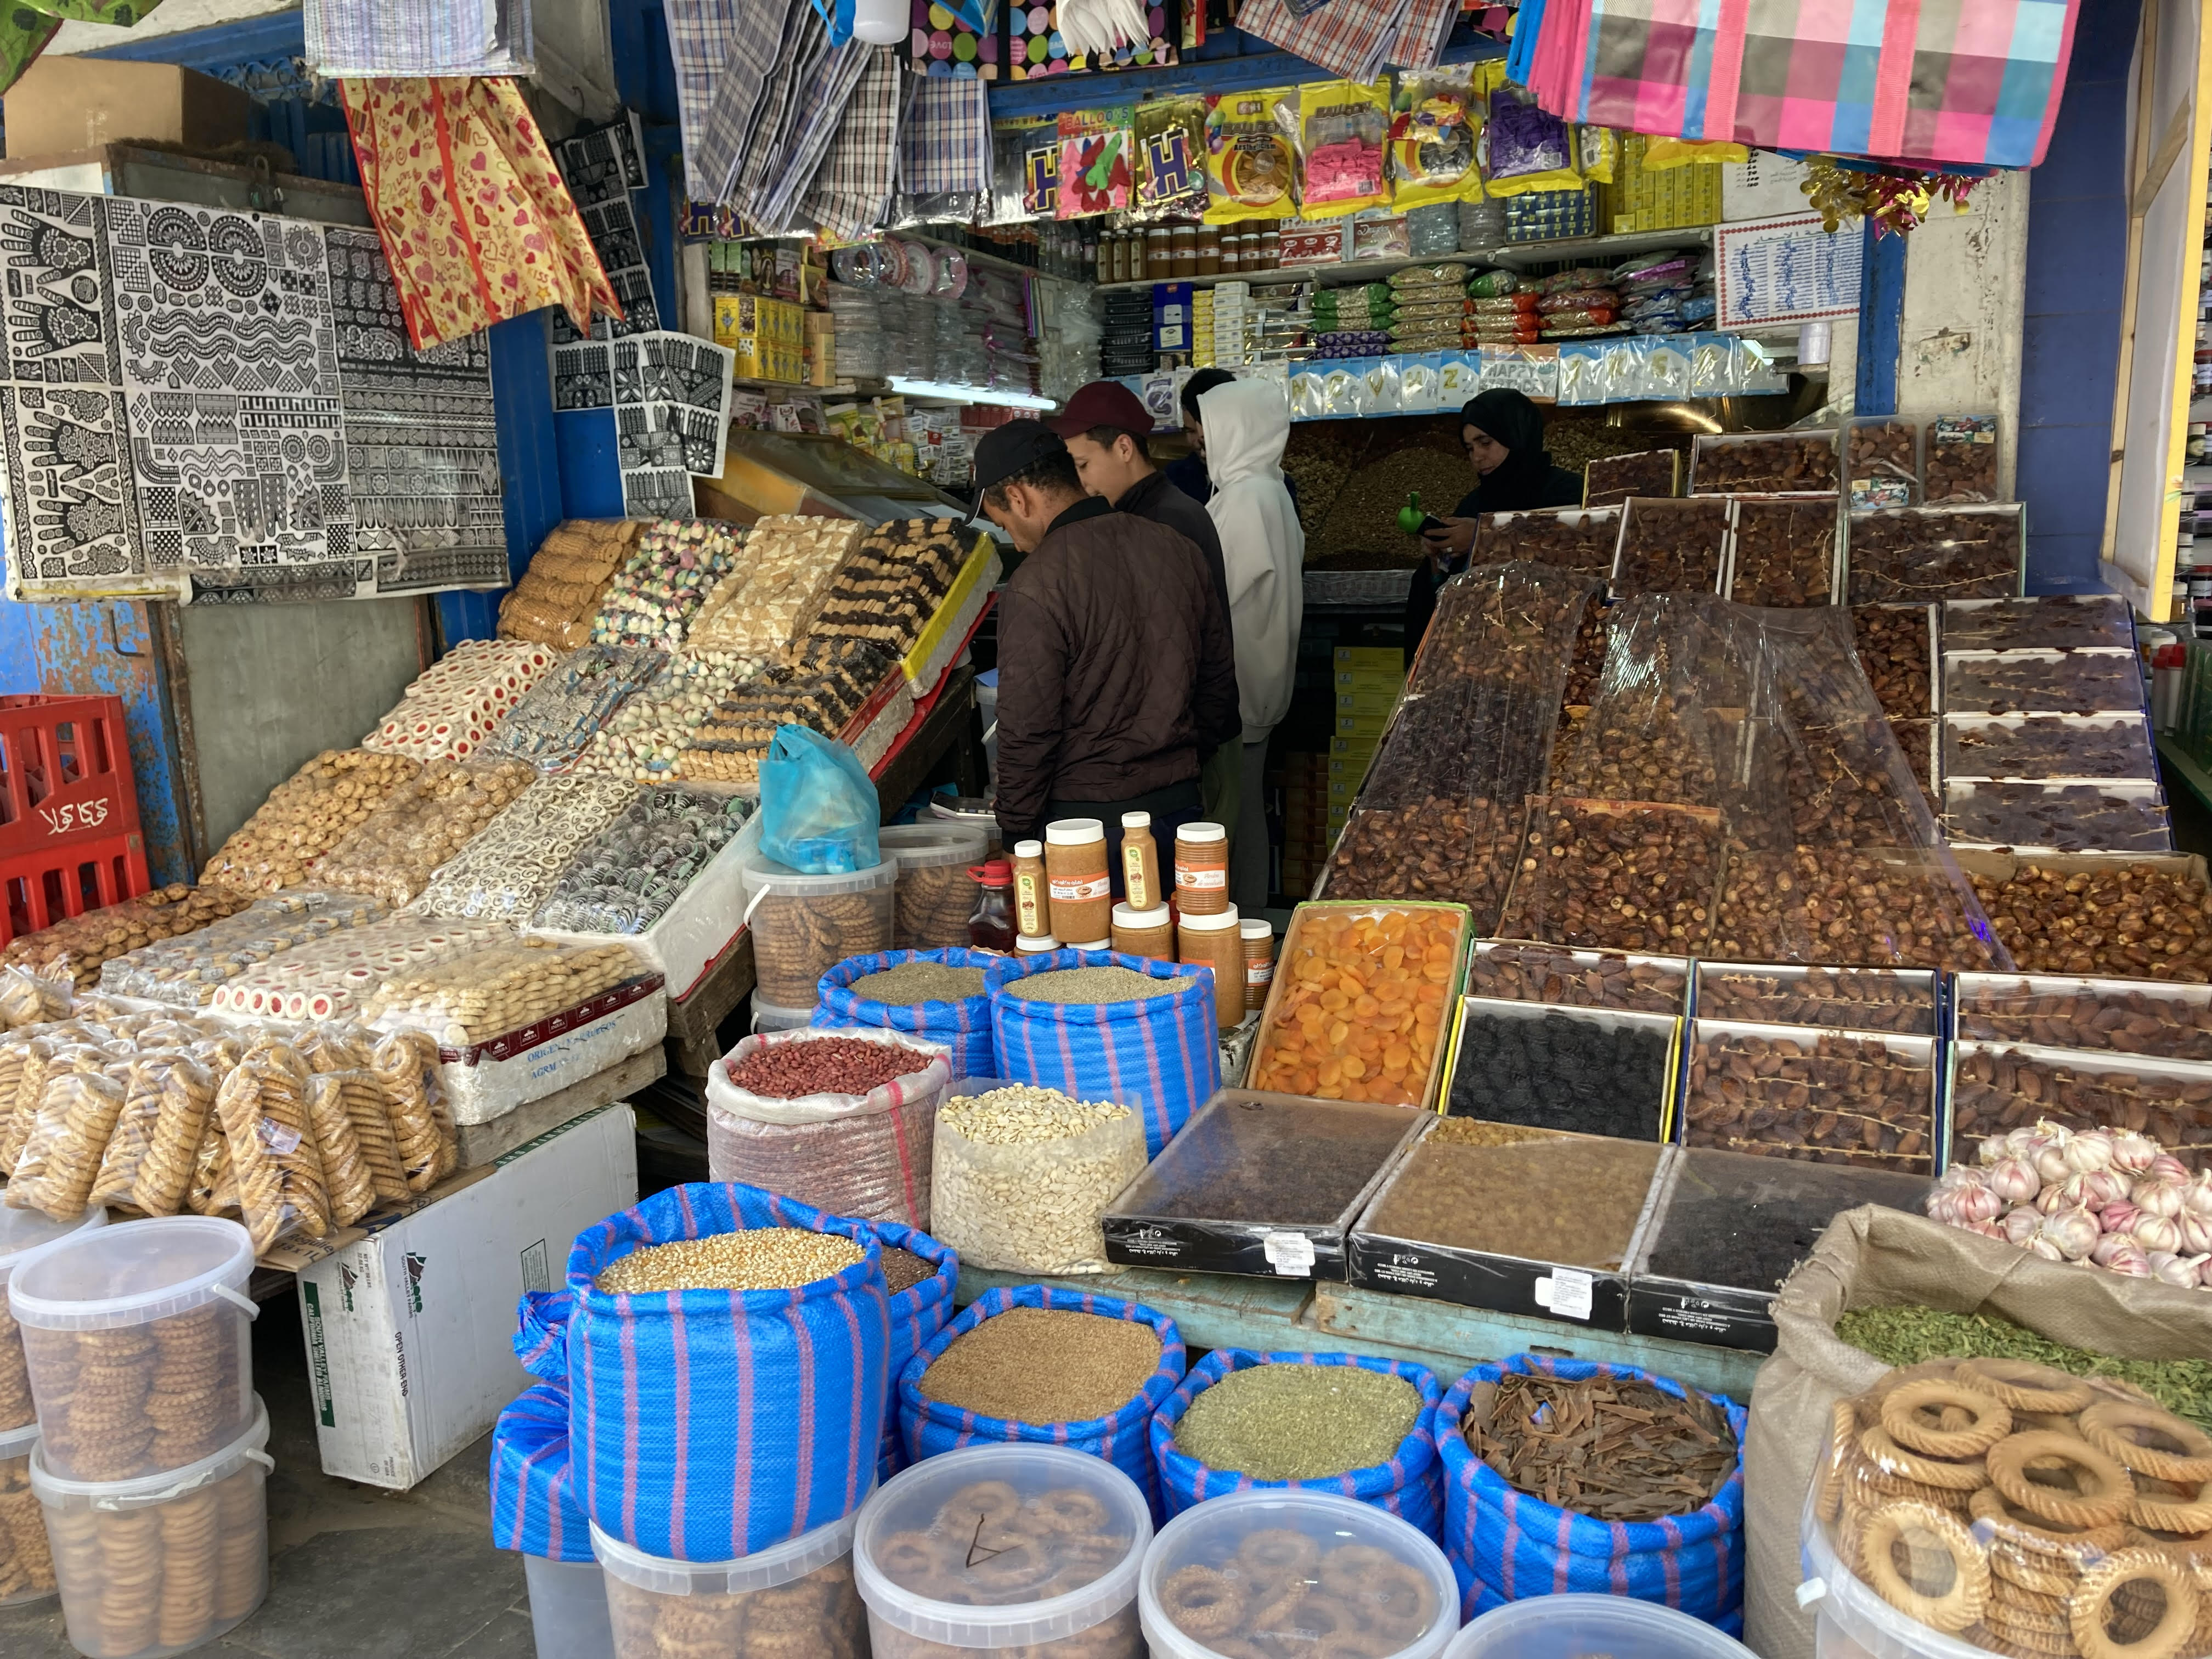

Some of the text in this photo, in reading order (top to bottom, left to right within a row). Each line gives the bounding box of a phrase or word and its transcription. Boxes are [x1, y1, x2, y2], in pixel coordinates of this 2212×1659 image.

[1065, 106, 1129, 130] BALLOONS
[1488, 363, 1536, 378] HAPPY
[39, 798, 108, 836] كوكا كولا
[307, 1303, 317, 1345] CALIFORNIA
[315, 1317, 324, 1341] SOUTH
[394, 1331, 403, 1353] OPEN
[319, 1342, 328, 1373] VALLEY
[398, 1353, 407, 1378] OTHER
